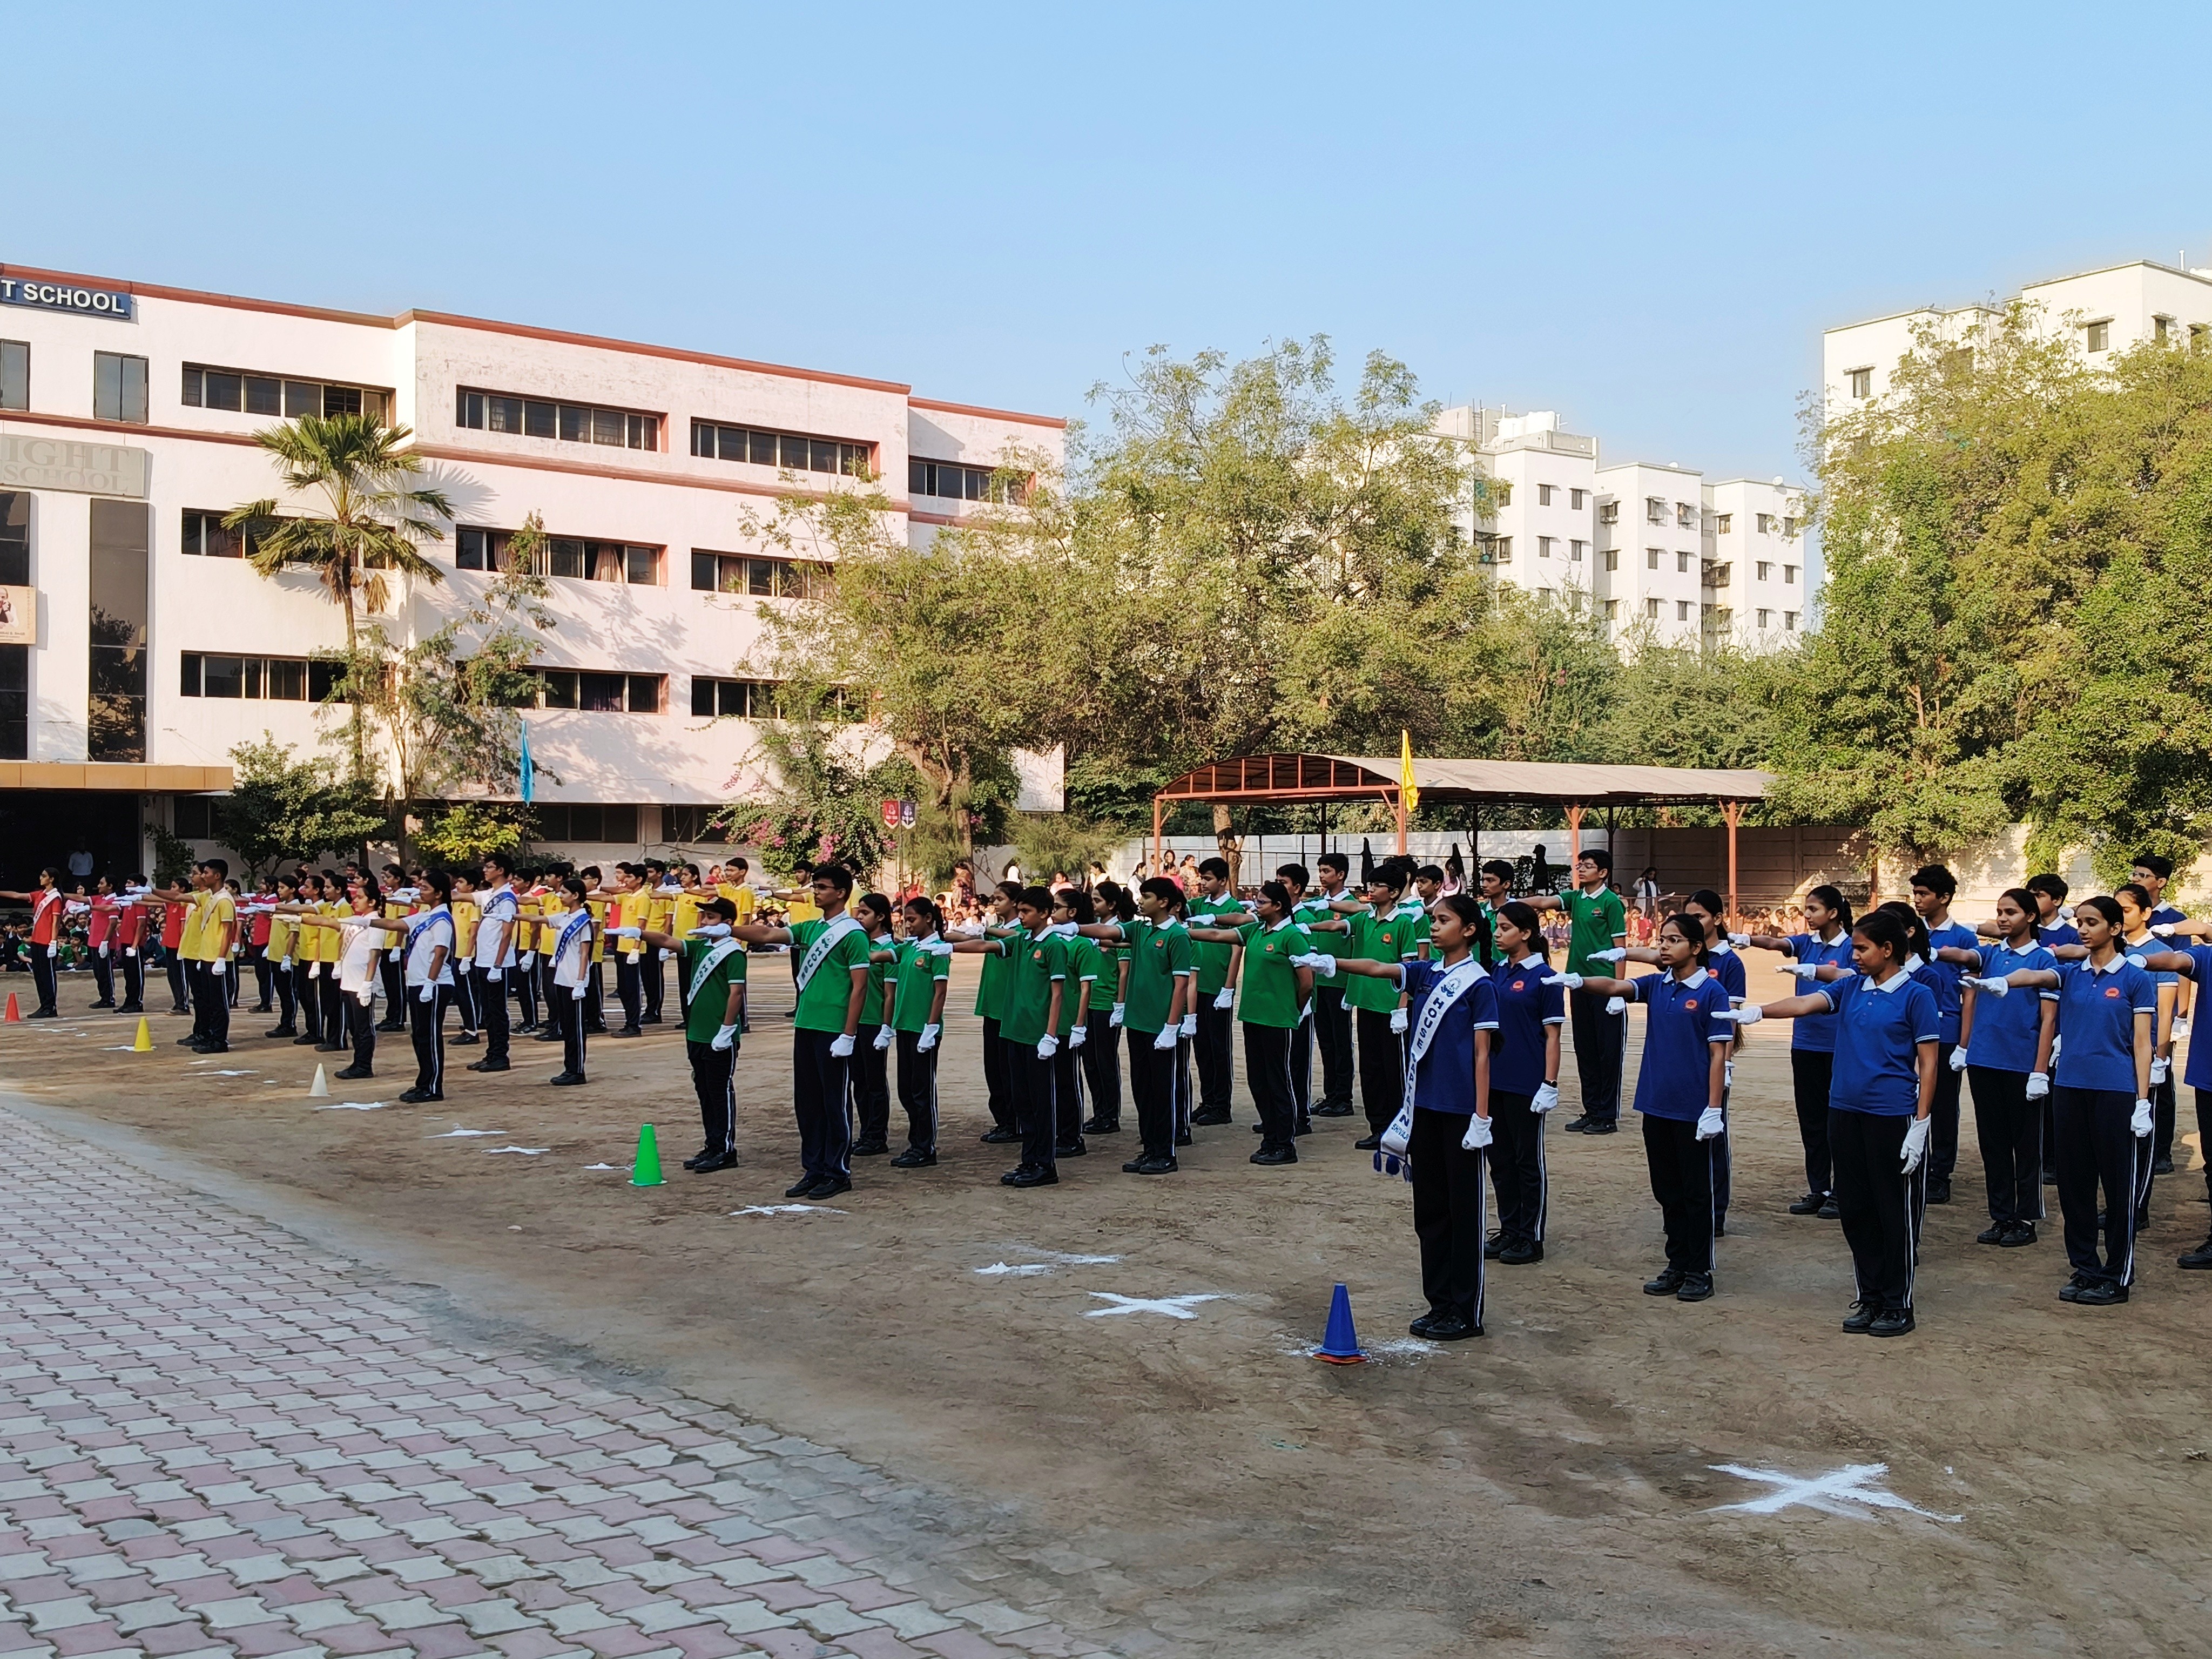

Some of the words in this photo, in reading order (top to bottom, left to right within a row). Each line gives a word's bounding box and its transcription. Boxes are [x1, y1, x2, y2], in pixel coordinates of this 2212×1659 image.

[23, 284, 125, 313] SCHOOL
[6, 437, 129, 473] IGHT
[3, 464, 129, 493] SCHOOL
[1417, 997, 1445, 1049] HOUSE
